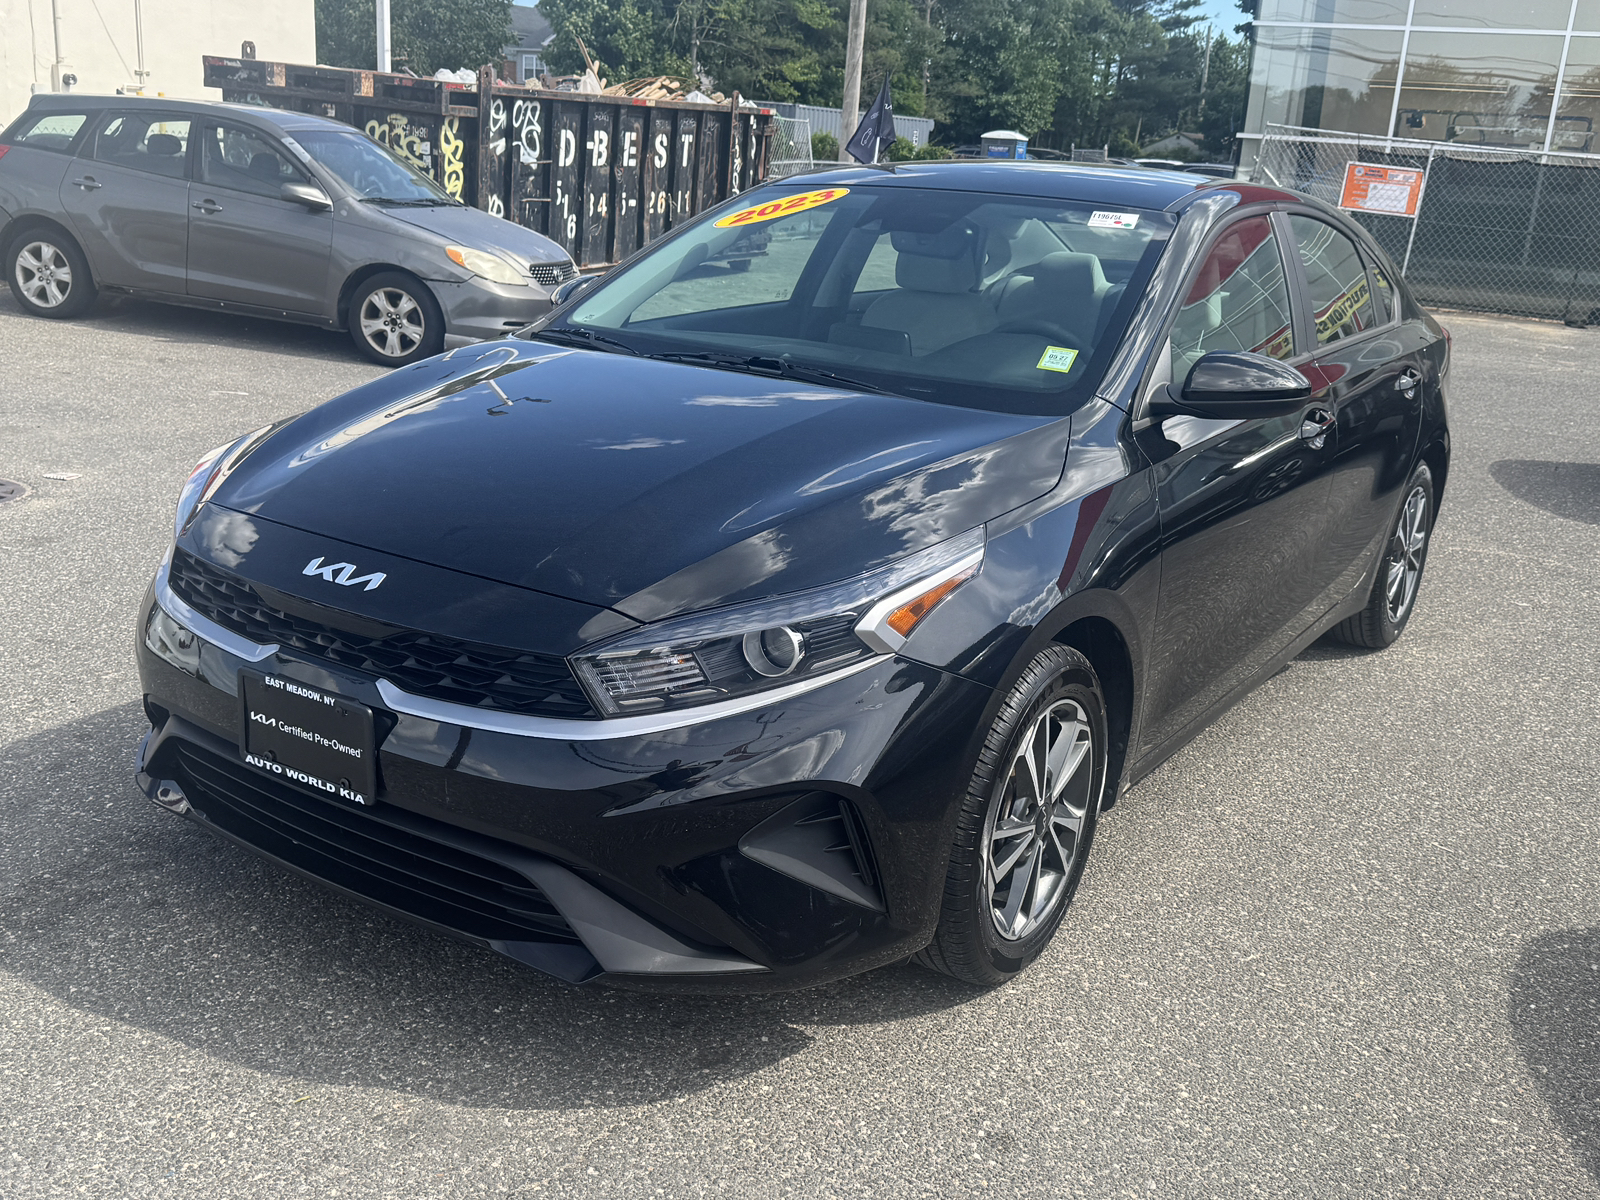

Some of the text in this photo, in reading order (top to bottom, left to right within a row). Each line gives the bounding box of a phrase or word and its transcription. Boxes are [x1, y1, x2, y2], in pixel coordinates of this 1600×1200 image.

[730, 189, 836, 226] 2023
[302, 556, 387, 592] KIA
[265, 676, 284, 689] EAST
[323, 695, 335, 707] NY
[250, 710, 361, 759] KIA Certified Pre-Owned
[245, 754, 365, 805] AUTO WORLD KIA
